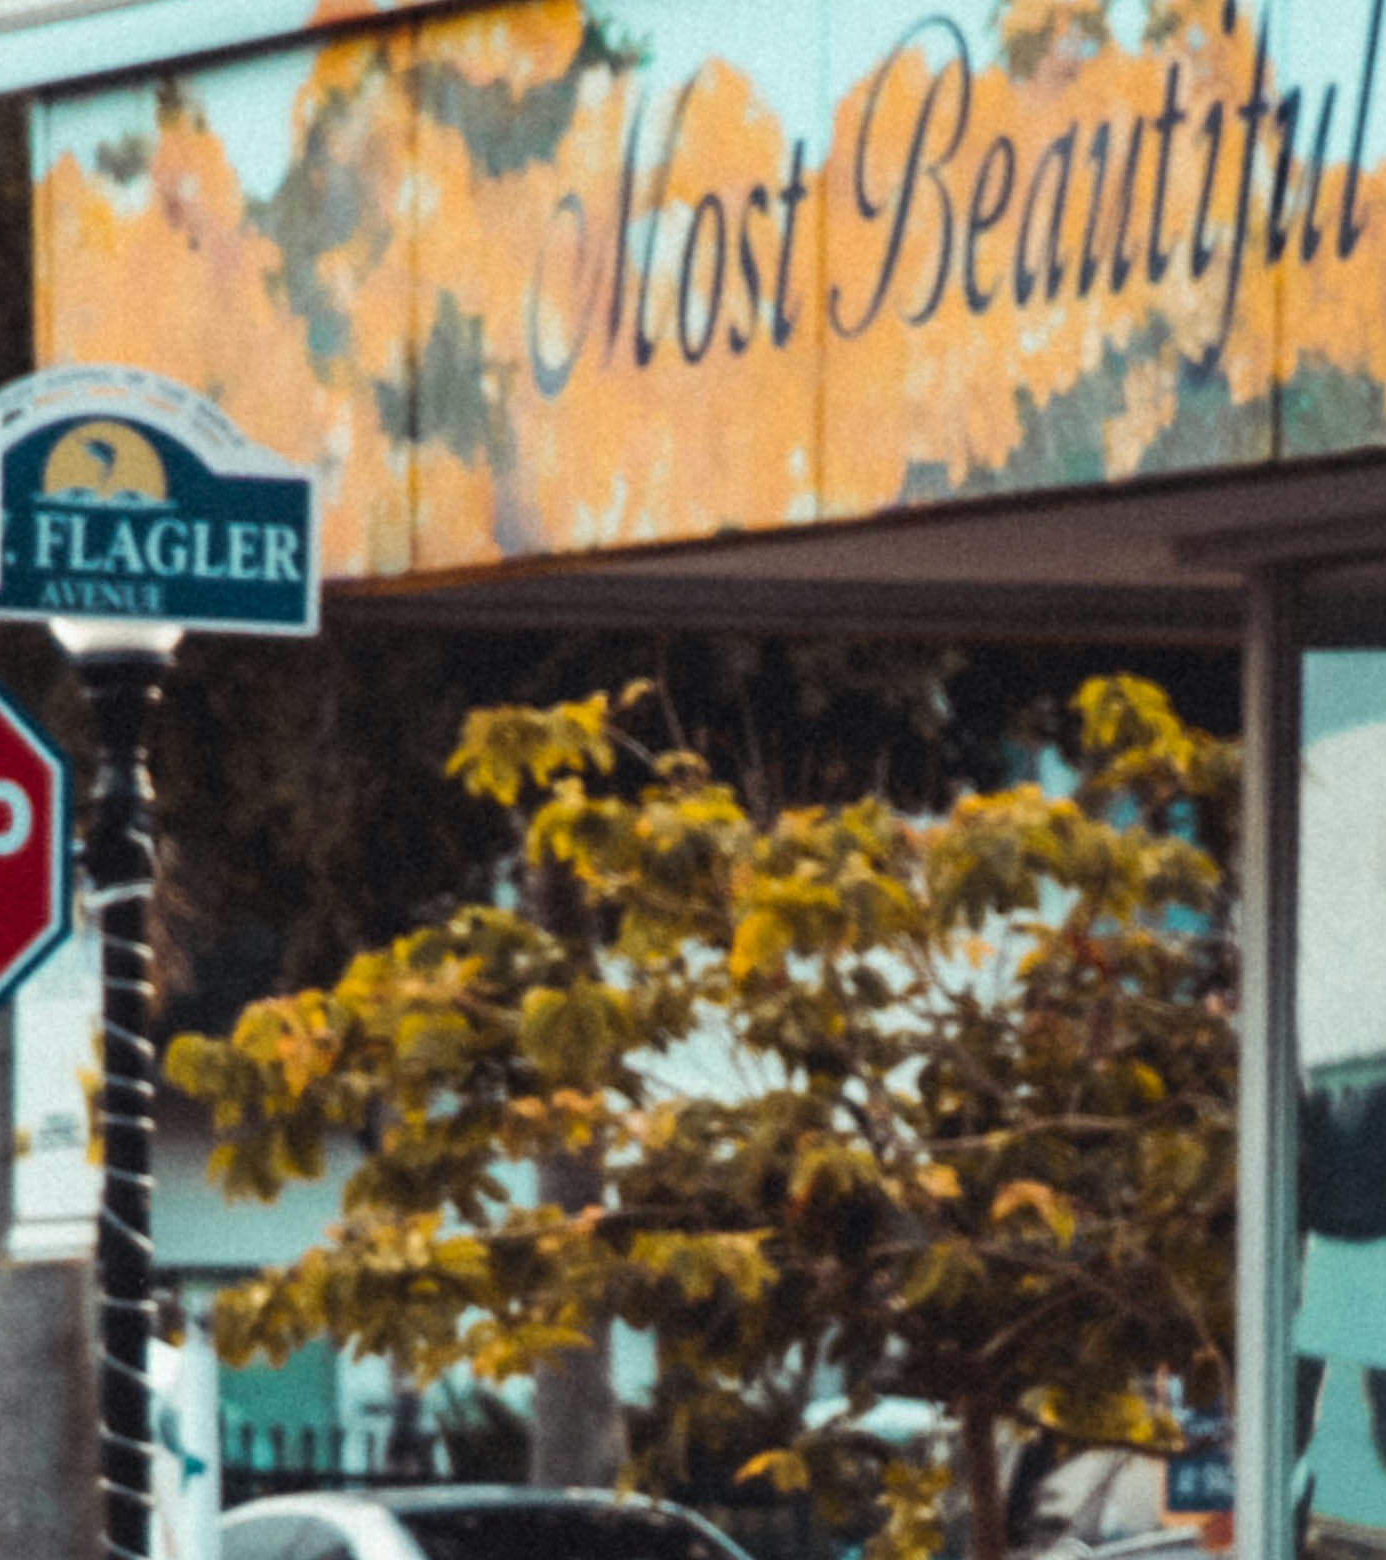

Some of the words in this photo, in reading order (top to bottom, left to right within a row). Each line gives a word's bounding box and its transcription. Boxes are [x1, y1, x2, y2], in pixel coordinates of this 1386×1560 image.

[527, 68, 807, 400] Most
[34, 512, 302, 582] FLAGLER
[40, 581, 165, 613] AVENUE
